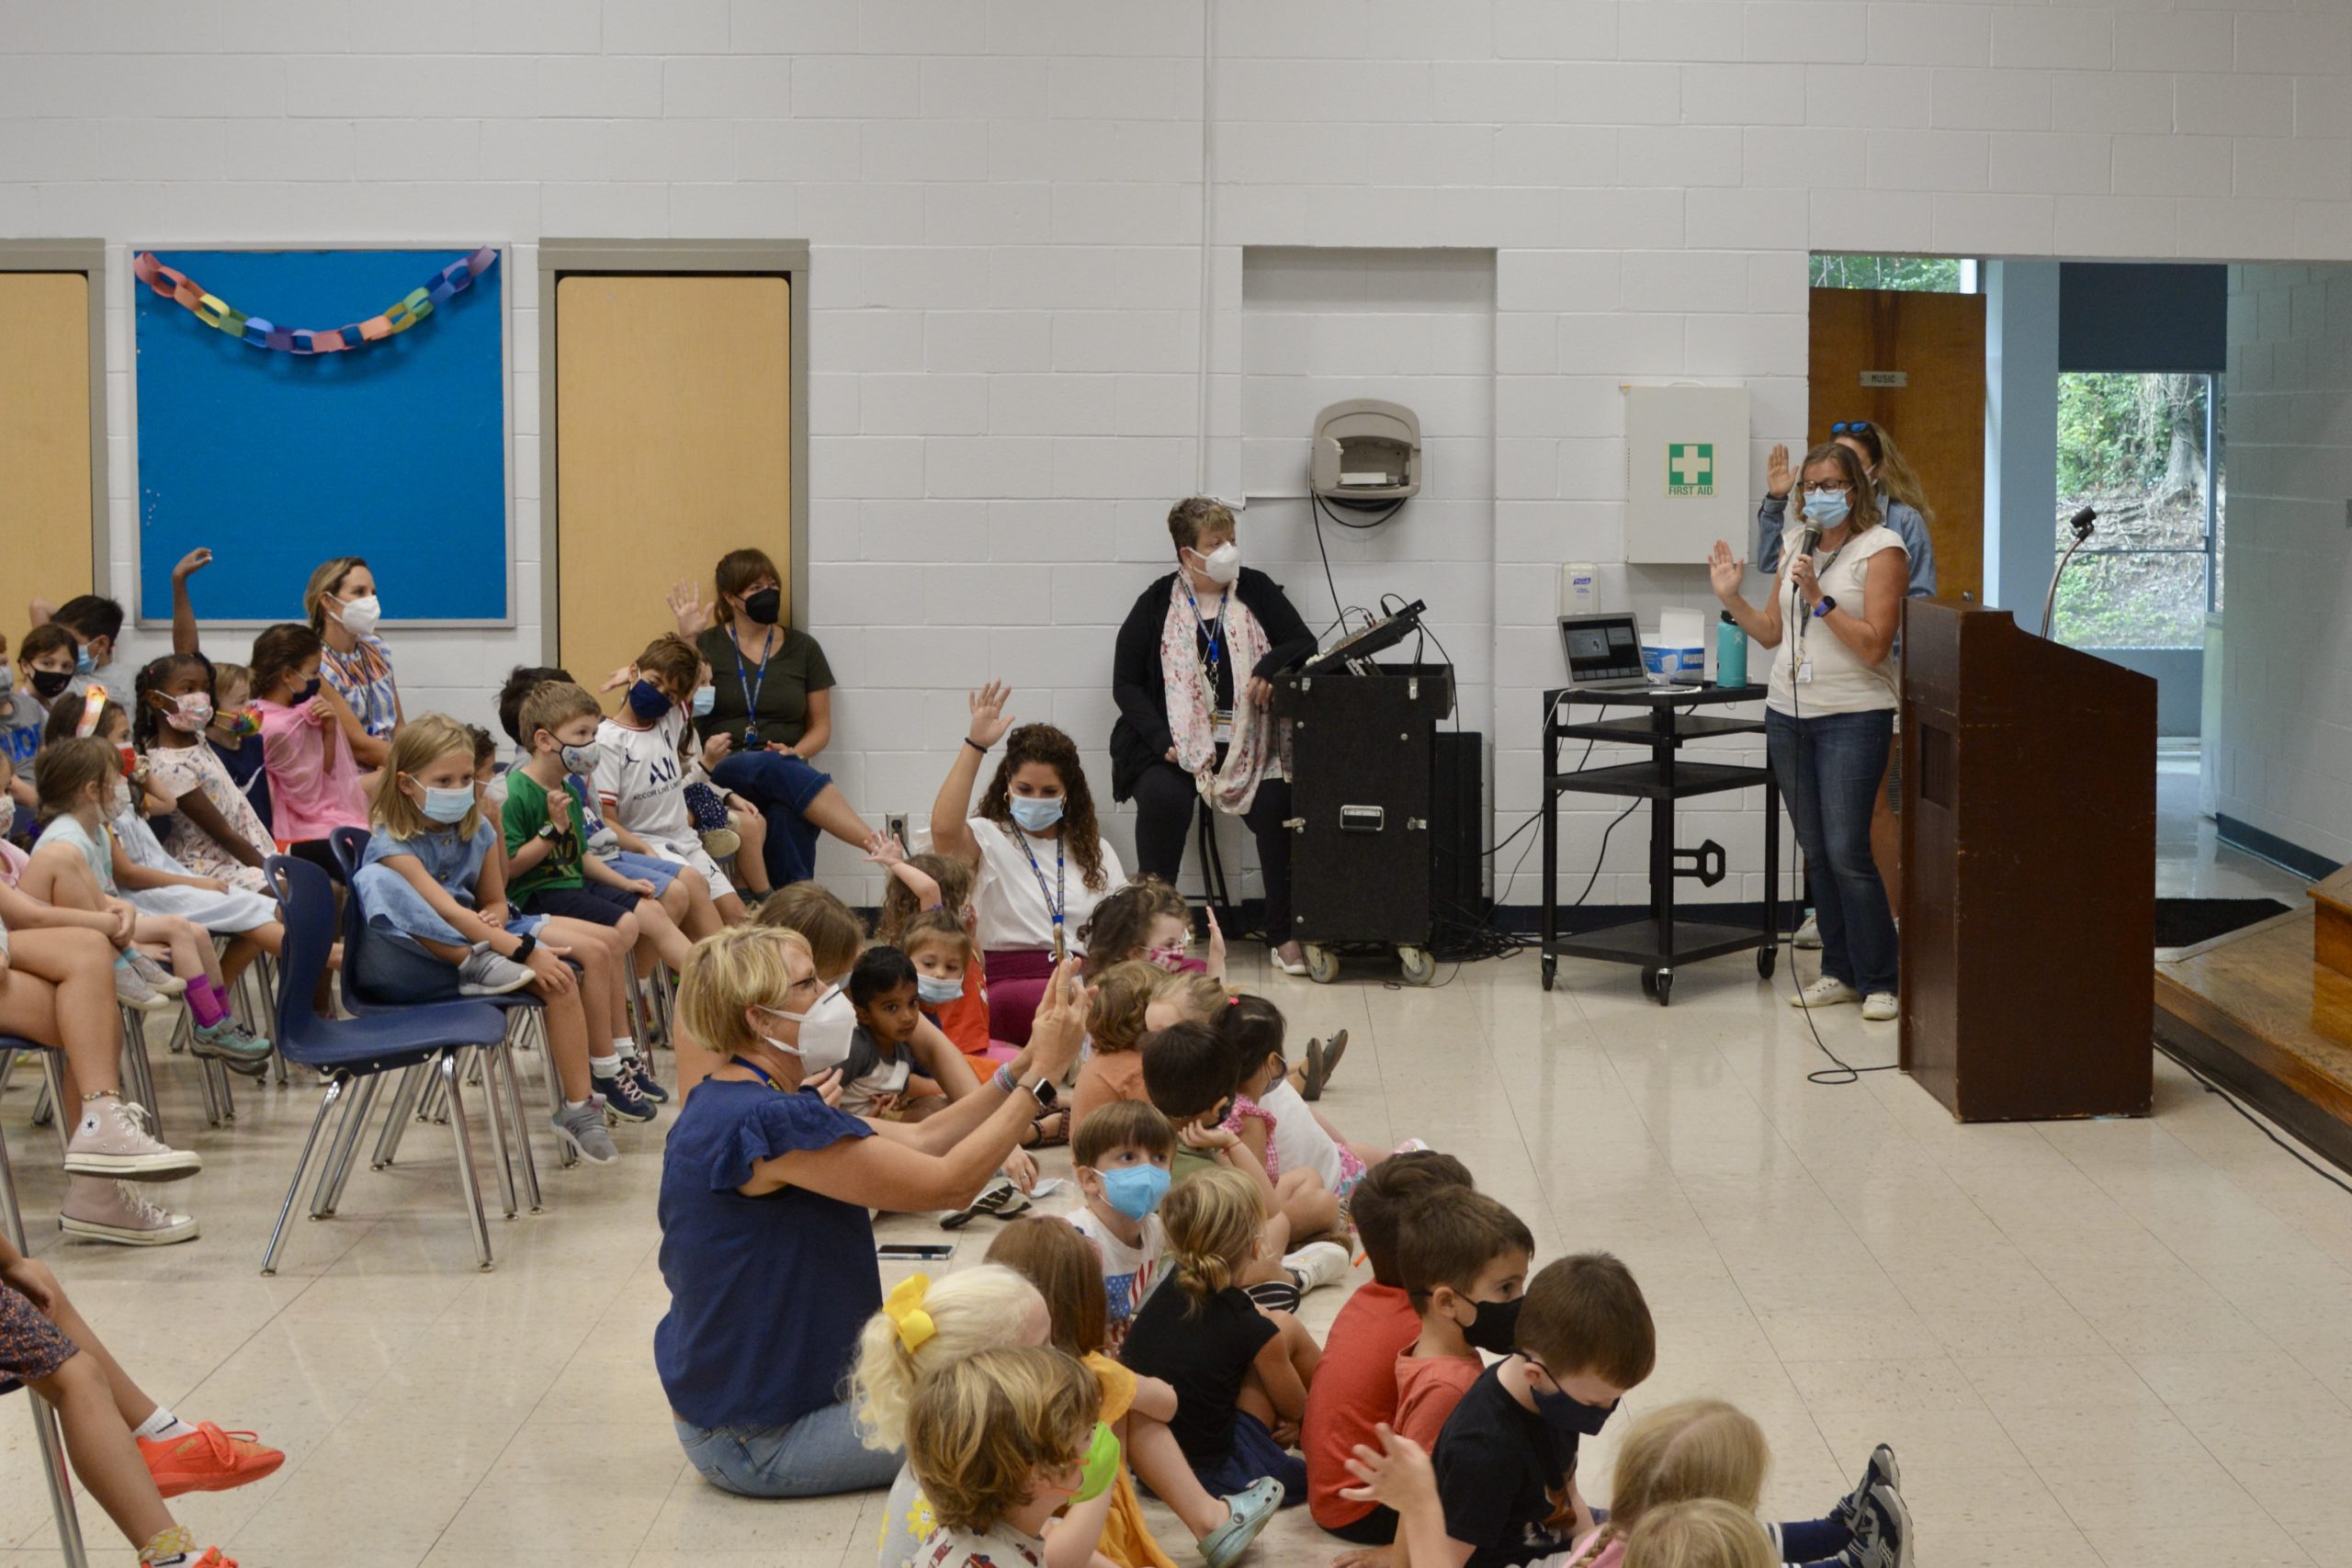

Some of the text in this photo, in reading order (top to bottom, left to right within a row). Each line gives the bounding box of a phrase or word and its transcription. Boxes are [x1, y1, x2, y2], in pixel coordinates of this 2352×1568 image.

[1871, 374, 1895, 383] MUSIC
[1668, 486, 1713, 495] FIRST AID
